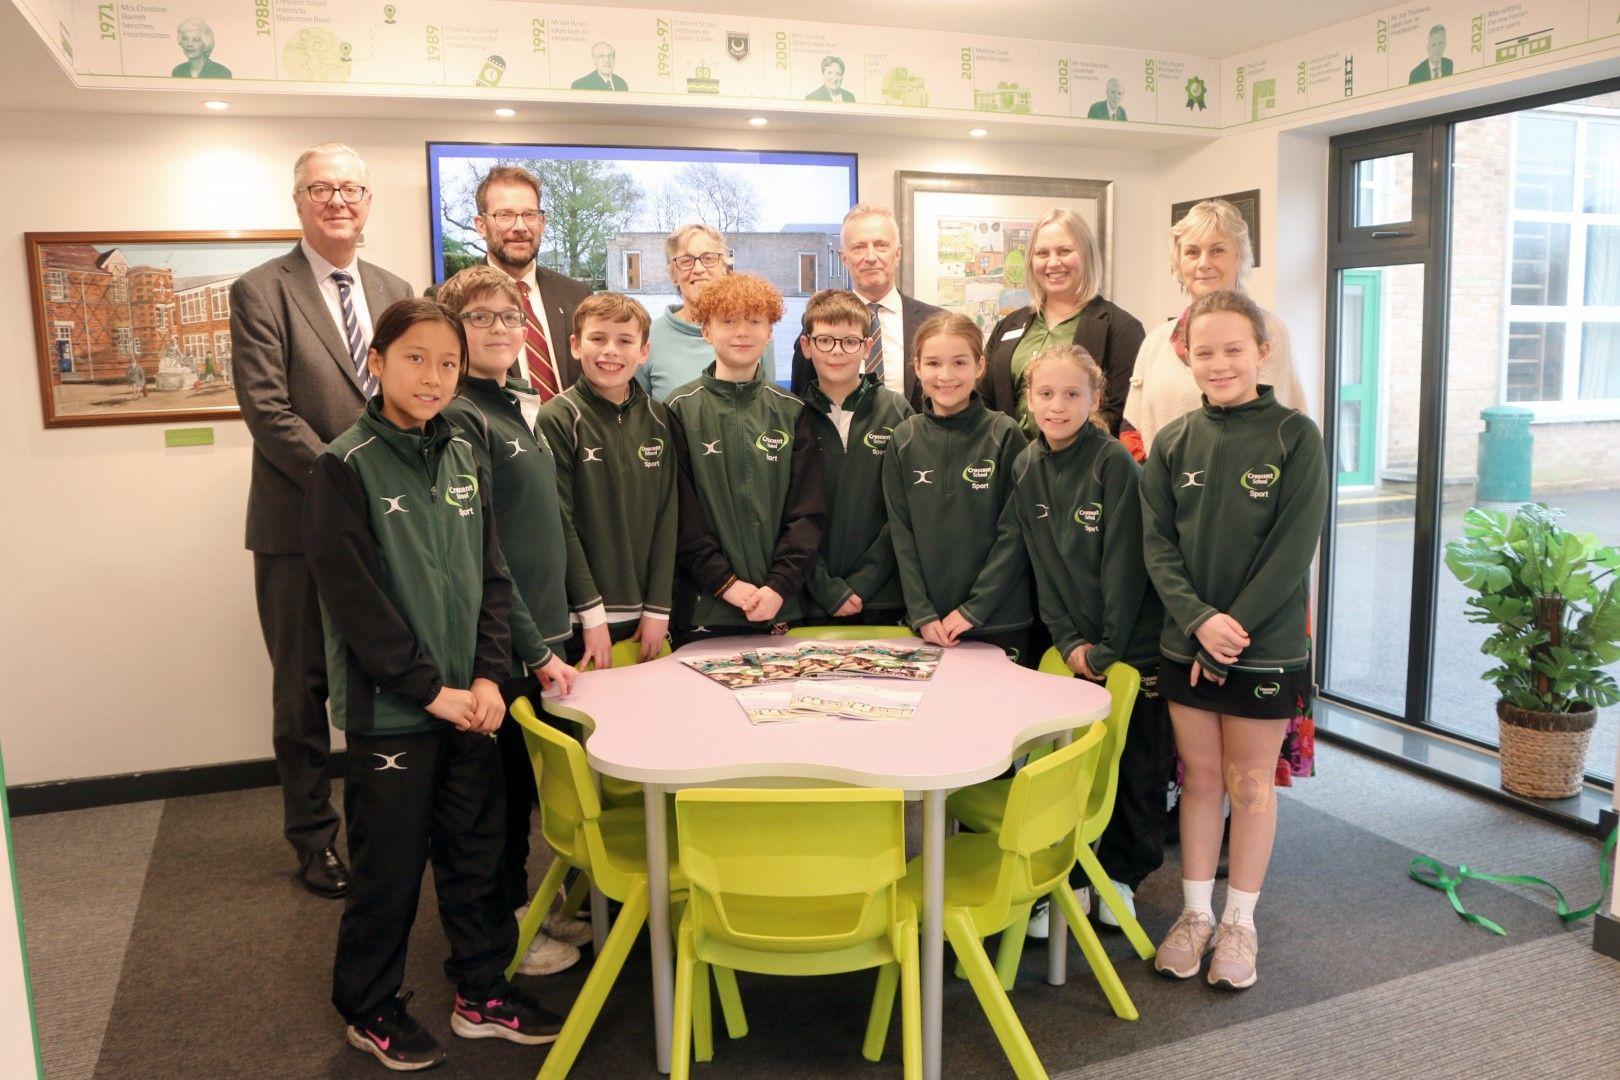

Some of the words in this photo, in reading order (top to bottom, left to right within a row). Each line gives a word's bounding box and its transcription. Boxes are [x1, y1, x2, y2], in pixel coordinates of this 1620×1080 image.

[98, 3, 116, 40] 1971
[121, 4, 135, 12] Mrs
[136, 5, 167, 13] Christine
[123, 31, 172, 40] Headmistress
[426, 25, 441, 62] 1989
[532, 18, 546, 54] 1992
[656, 17, 671, 78] 1996-97
[775, 31, 787, 69] 2000
[1376, 19, 1387, 53] 2017
[1471, 13, 1482, 53] 2021
[961, 46, 972, 80] 2001
[1059, 59, 1069, 94] 2002
[1145, 58, 1155, 93] 2005
[1297, 60, 1306, 95] 2016
[644, 460, 660, 468] Sport
[971, 482, 989, 490] Sport
[1250, 490, 1269, 499] Sport
